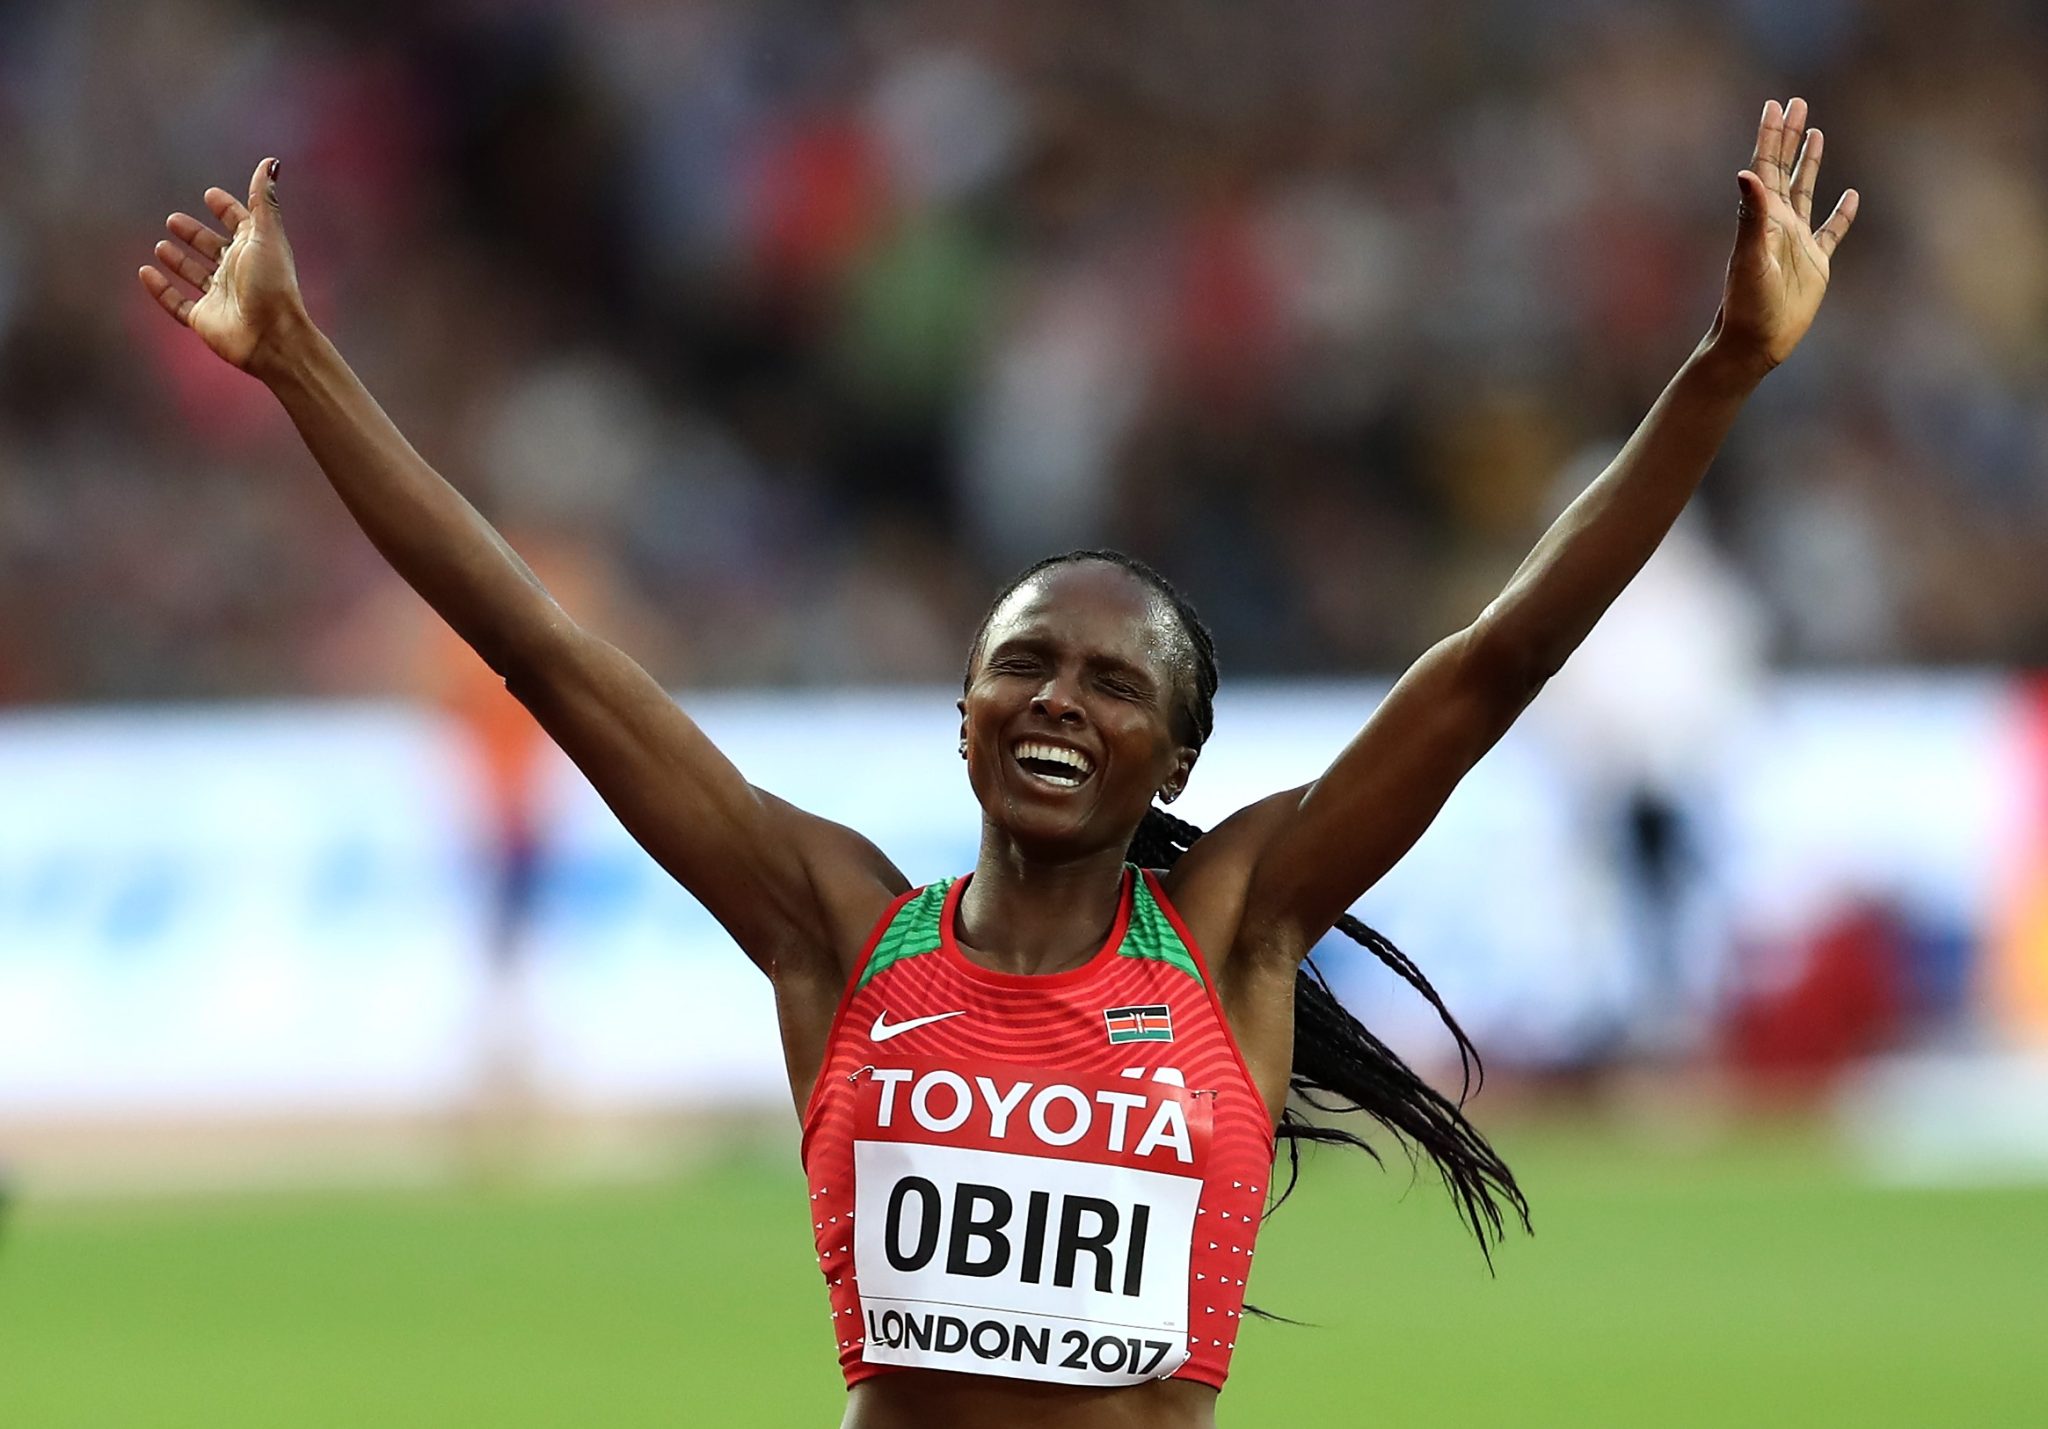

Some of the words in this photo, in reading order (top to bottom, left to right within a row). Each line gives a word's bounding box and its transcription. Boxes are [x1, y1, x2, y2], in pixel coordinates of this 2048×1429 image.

[871, 1069, 1194, 1163] TOYOTA
[884, 1176, 1150, 1297] OBIRI
[868, 1310, 1050, 1364] LONDON
[1060, 1330, 1173, 1375] 2017
